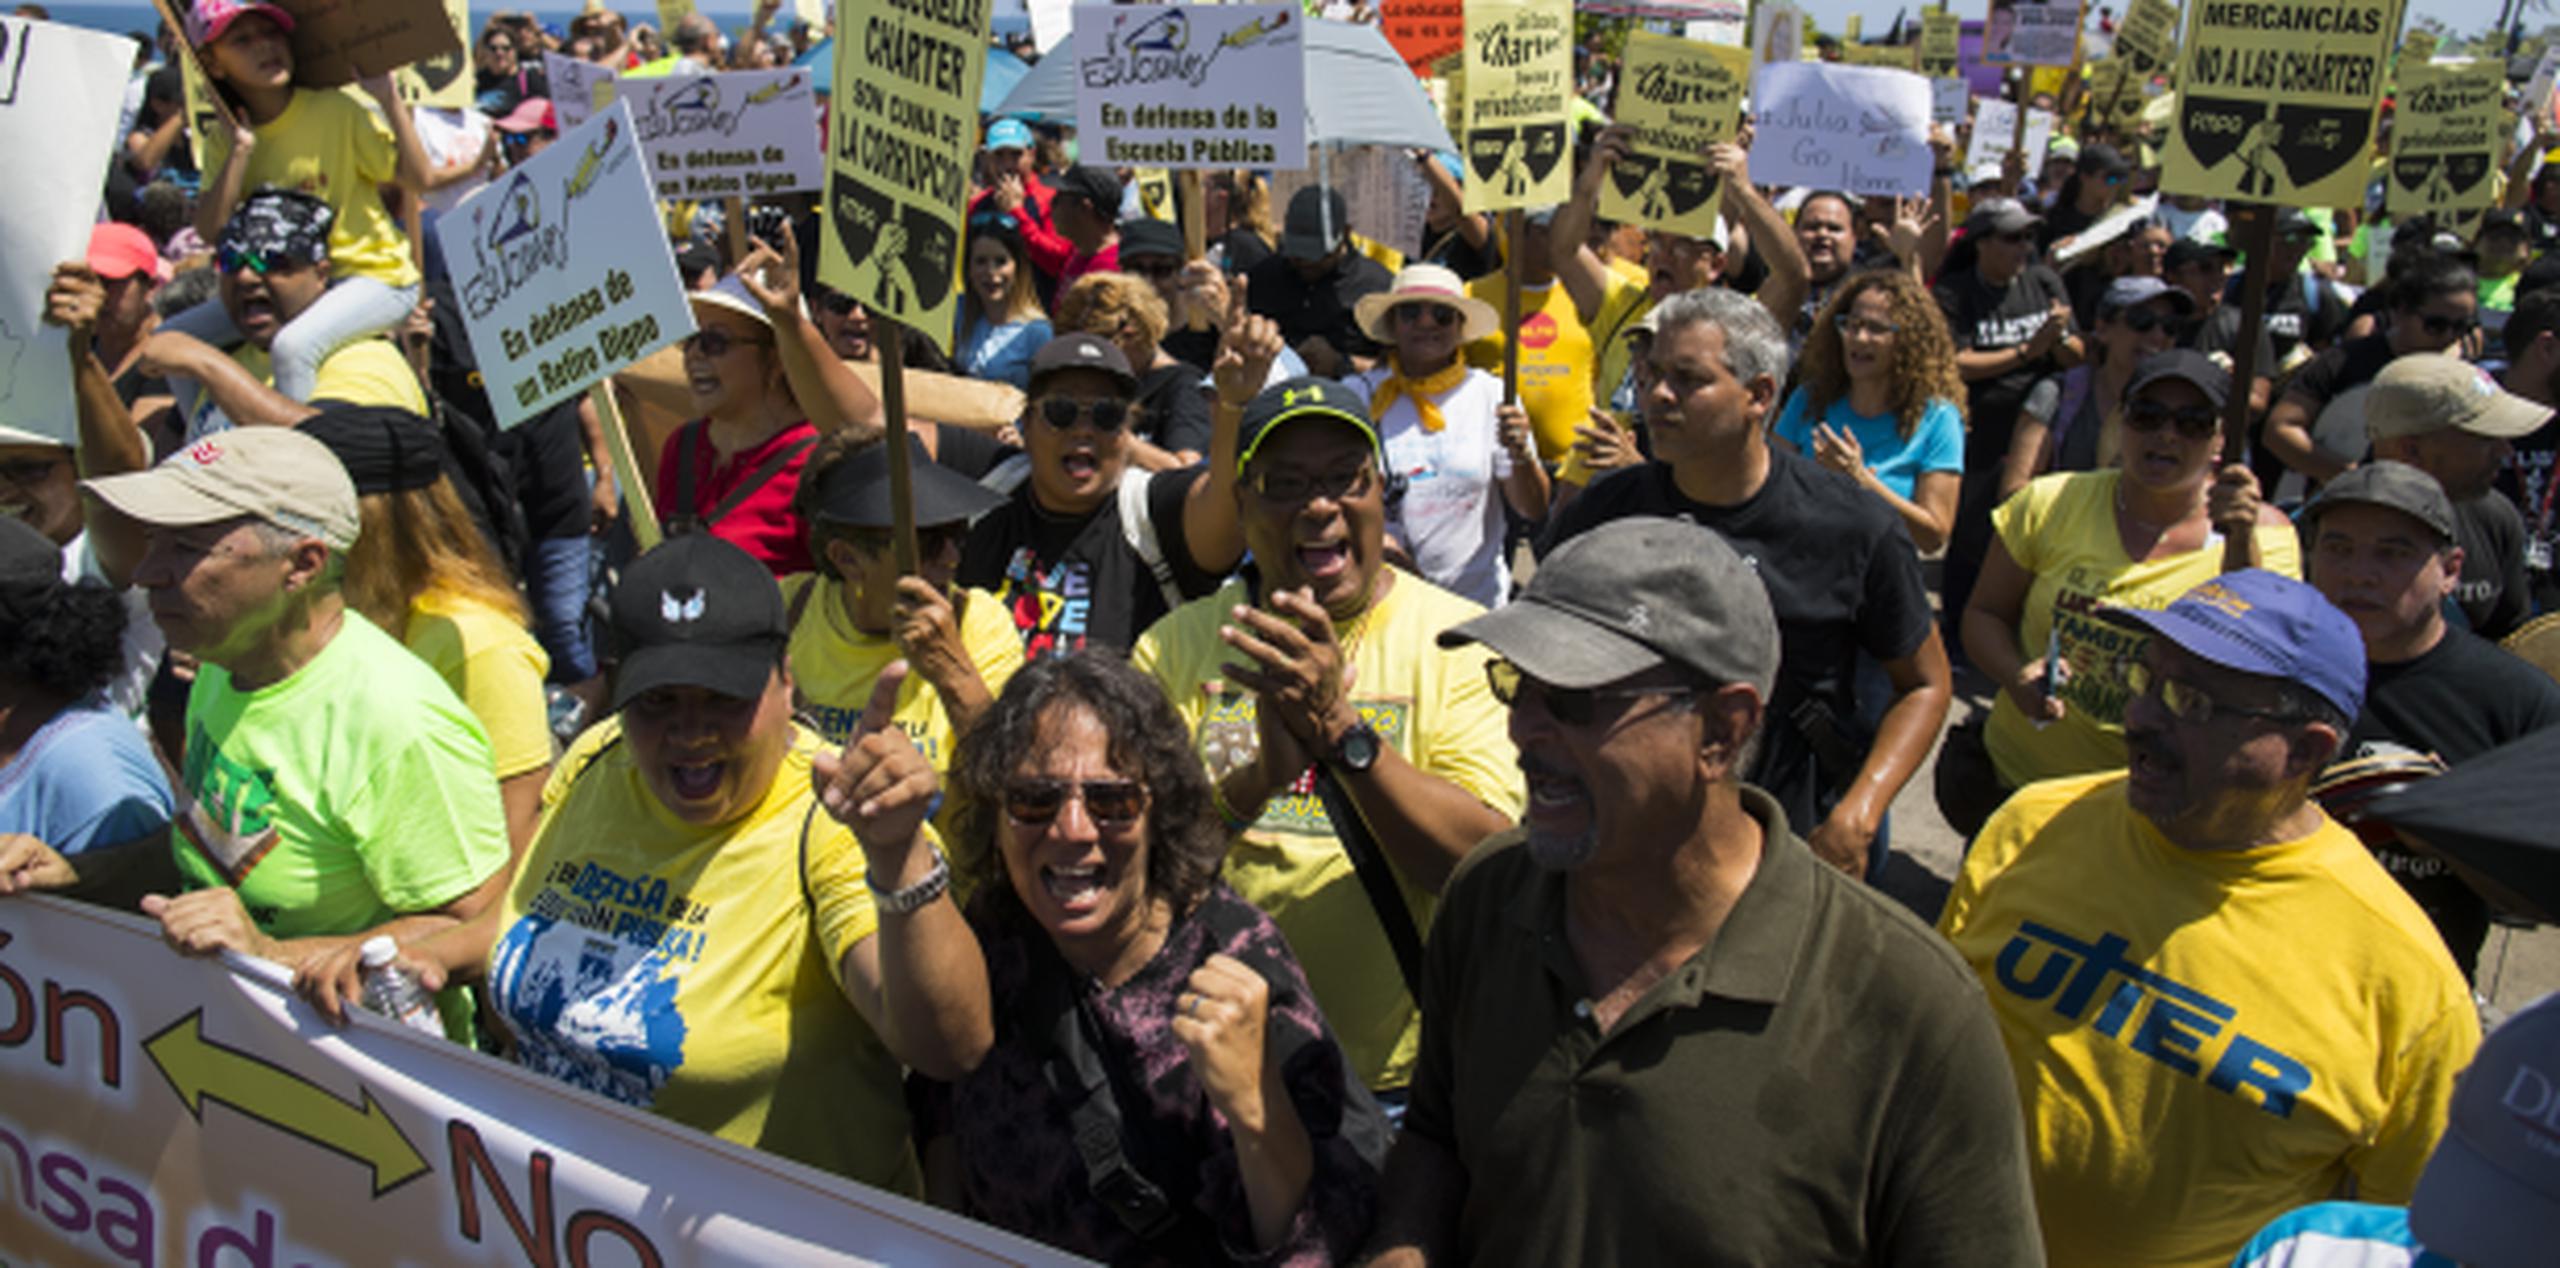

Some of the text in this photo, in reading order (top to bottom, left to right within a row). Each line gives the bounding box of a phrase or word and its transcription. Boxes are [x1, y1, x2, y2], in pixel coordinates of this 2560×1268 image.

[888, 0, 984, 37] UELAS
[2203, 0, 2382, 34] MERCANCÍAS
[865, 15, 965, 99] CHÁRTER
[2189, 42, 2376, 96] NO A LAS CHÁRTER
[853, 78, 884, 116] SON
[1100, 102, 1278, 129] En defensa de la
[657, 150, 680, 171] En
[763, 144, 786, 164] de
[840, 112, 858, 166] LA
[1105, 136, 1277, 163] Escuela Pública
[502, 267, 635, 363] En defensa de
[514, 312, 662, 409] un Retiro Digno
[2053, 608, 2150, 656] TAMBI
[0, 928, 122, 1090] ón
[0, 1127, 155, 1268] nsa
